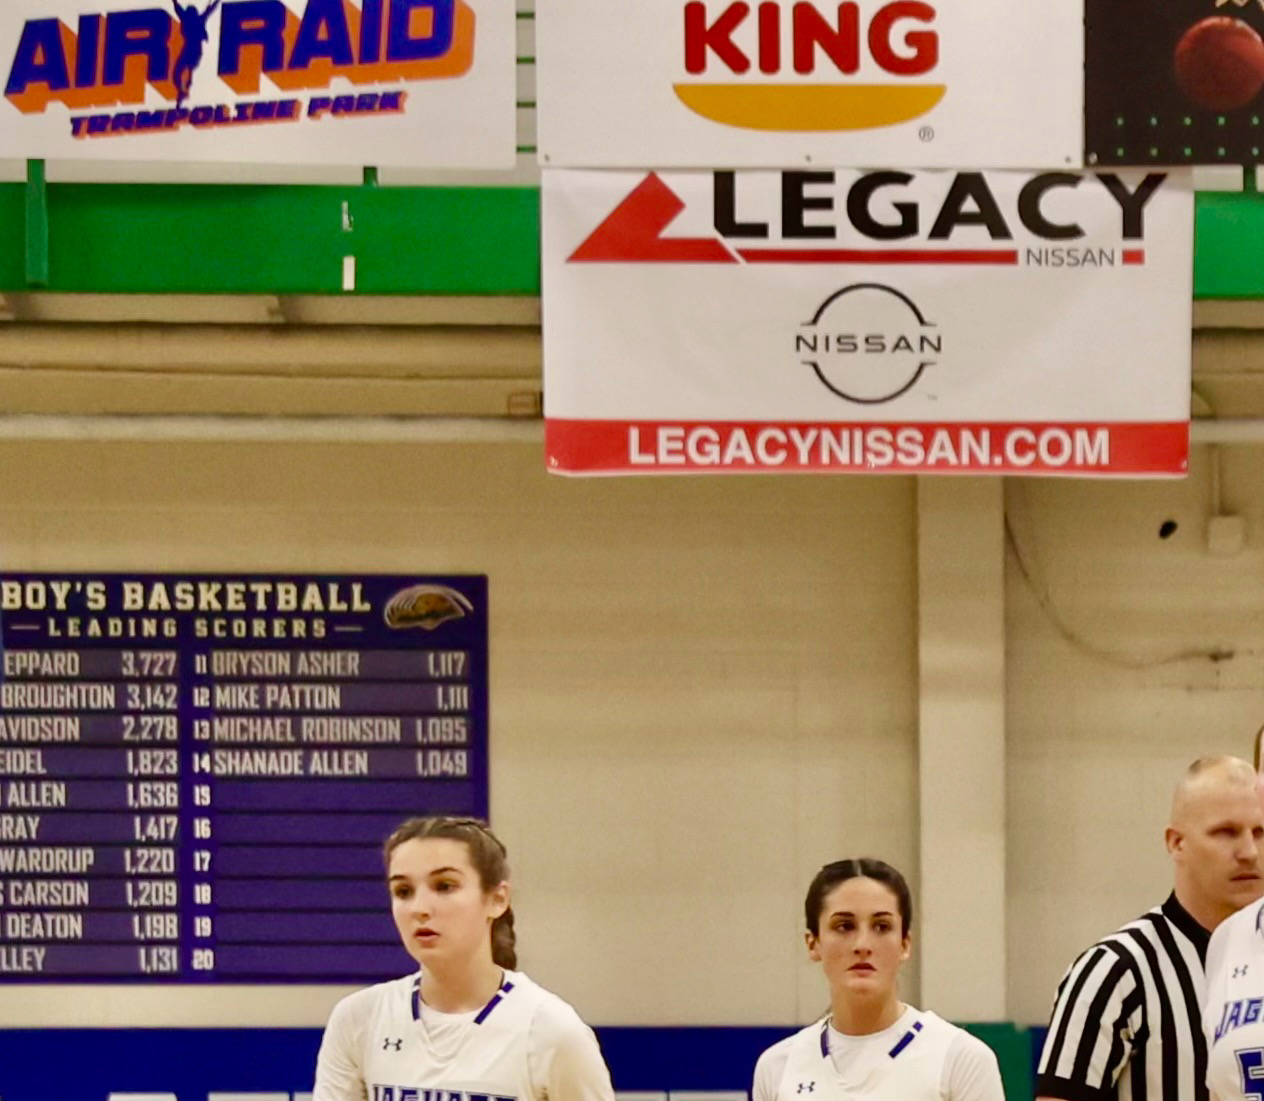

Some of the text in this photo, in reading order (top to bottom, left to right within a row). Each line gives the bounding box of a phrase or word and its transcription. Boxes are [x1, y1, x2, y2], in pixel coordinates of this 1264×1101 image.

[4, 0, 462, 103] AIR RAID
[684, 0, 939, 77] KING
[70, 91, 405, 138] TRAMPOLINE PARK
[713, 170, 1168, 241] LEGACY
[1026, 248, 1116, 268] NISSAN
[795, 334, 942, 354] NISSAN
[627, 426, 1111, 467] LEGACYNISSAN.COM
[1, 581, 371, 611] BOY'S BASKETBALL
[49, 617, 326, 637] LEADING SCORERS
[121, 652, 177, 677] 3,727
[297, 652, 359, 676] ASHER
[428, 652, 465, 677] 1,117
[1, 684, 178, 710] BROUGHTON 3,142
[193, 685, 468, 710] 12 MIKE PATTON 1,111
[122, 715, 178, 741] 2,278
[193, 717, 467, 743] 13 MICHAEL ROBINSON 1,095
[127, 750, 178, 776] 1,823
[193, 751, 467, 776] 14 SHANADE ALLEN 1,049
[8, 783, 178, 809] ALLEN 1,636
[193, 785, 211, 806] 15
[134, 816, 179, 842] 1,417
[193, 817, 211, 839] 16
[124, 849, 175, 875] 1,220
[193, 851, 211, 872] 17
[10, 881, 89, 906] CARSON
[126, 882, 178, 907] 1,209
[193, 884, 212, 905] 18
[7, 913, 178, 940] DEATON 1,198
[194, 916, 212, 937] 19
[140, 947, 178, 973] 1,131
[192, 949, 214, 970] 20
